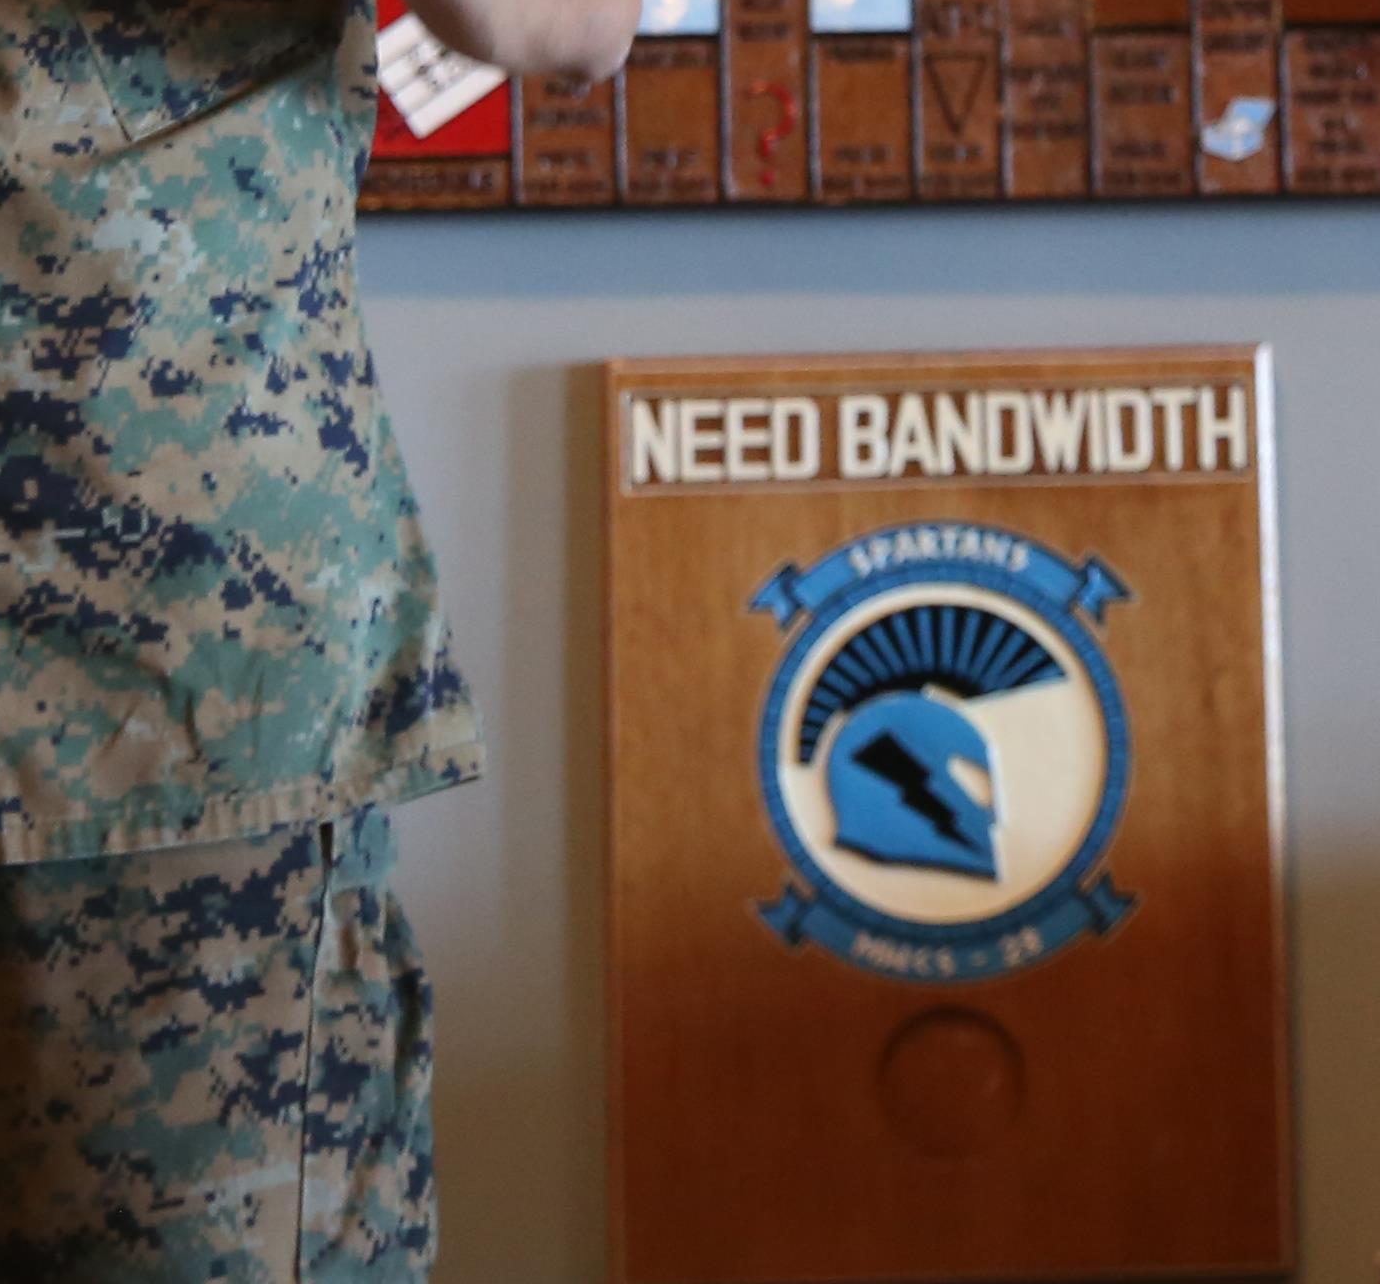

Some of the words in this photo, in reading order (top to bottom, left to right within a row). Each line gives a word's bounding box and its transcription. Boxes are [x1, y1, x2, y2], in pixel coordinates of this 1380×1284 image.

[631, 397, 819, 483] NEED
[838, 386, 1249, 479] BANDWIDTH
[849, 525, 1029, 579] SPARTANS
